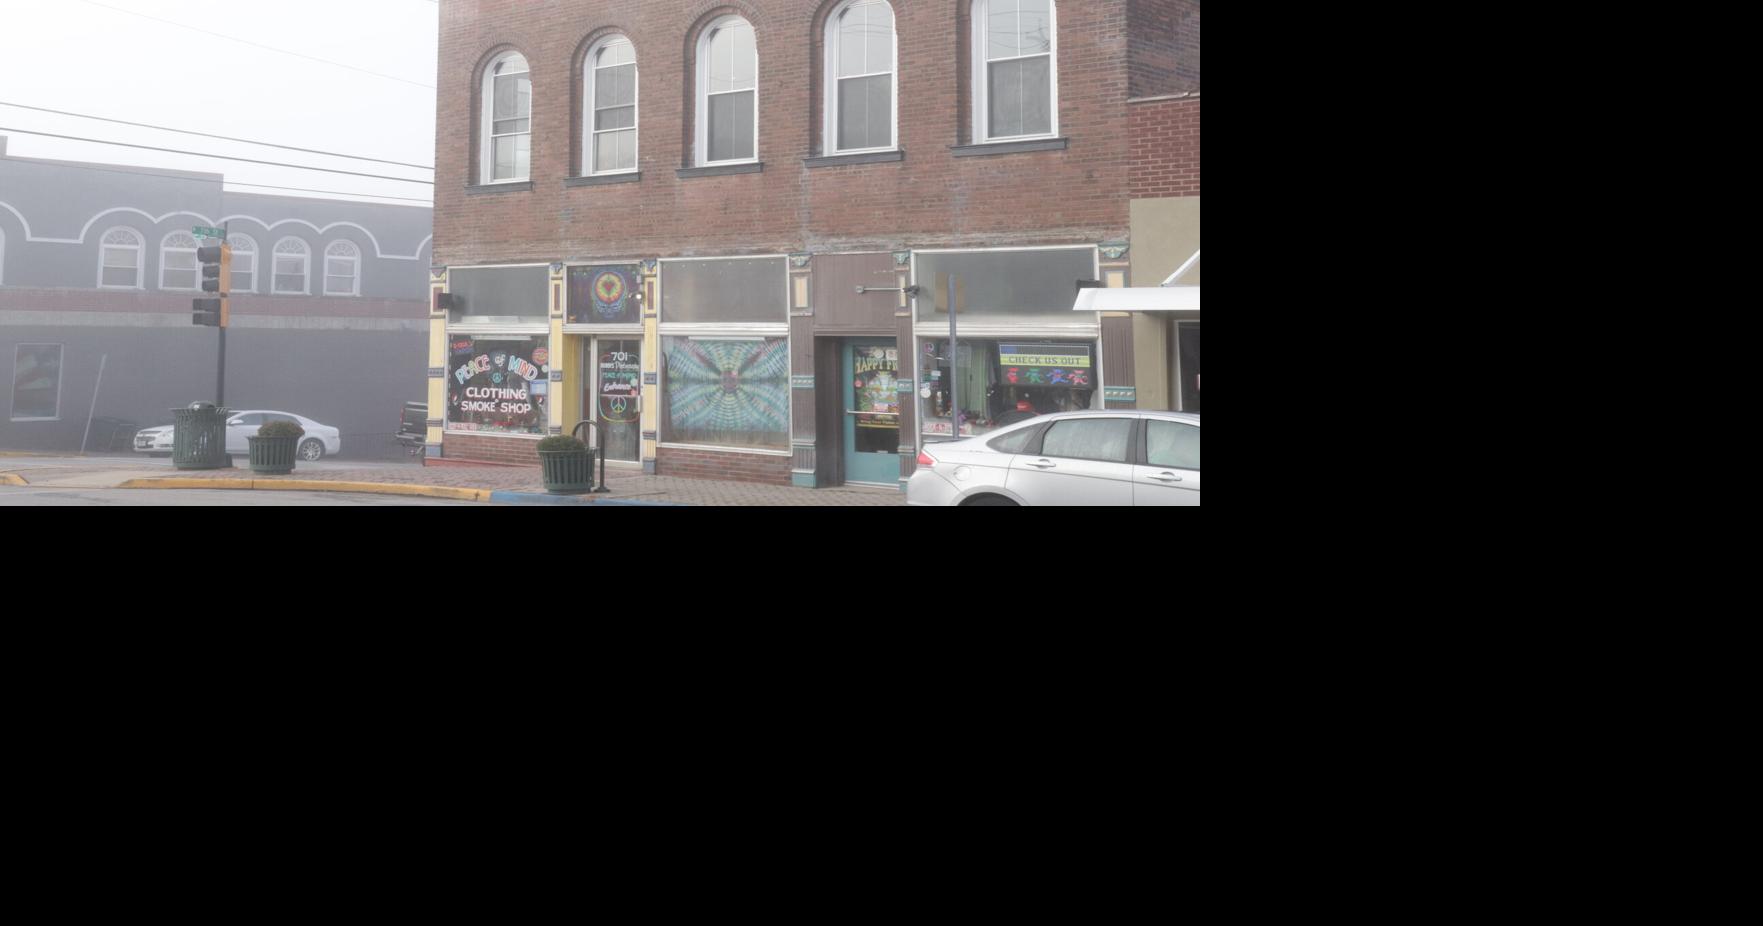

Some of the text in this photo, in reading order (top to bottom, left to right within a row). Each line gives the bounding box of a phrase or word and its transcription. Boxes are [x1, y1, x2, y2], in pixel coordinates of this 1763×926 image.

[611, 352, 628, 361] 701
[1008, 356, 1081, 365] CHECK US OUT
[508, 355, 538, 381] MIND
[466, 387, 528, 400] CLOTHING
[461, 401, 532, 414] SMOKE SHOP
